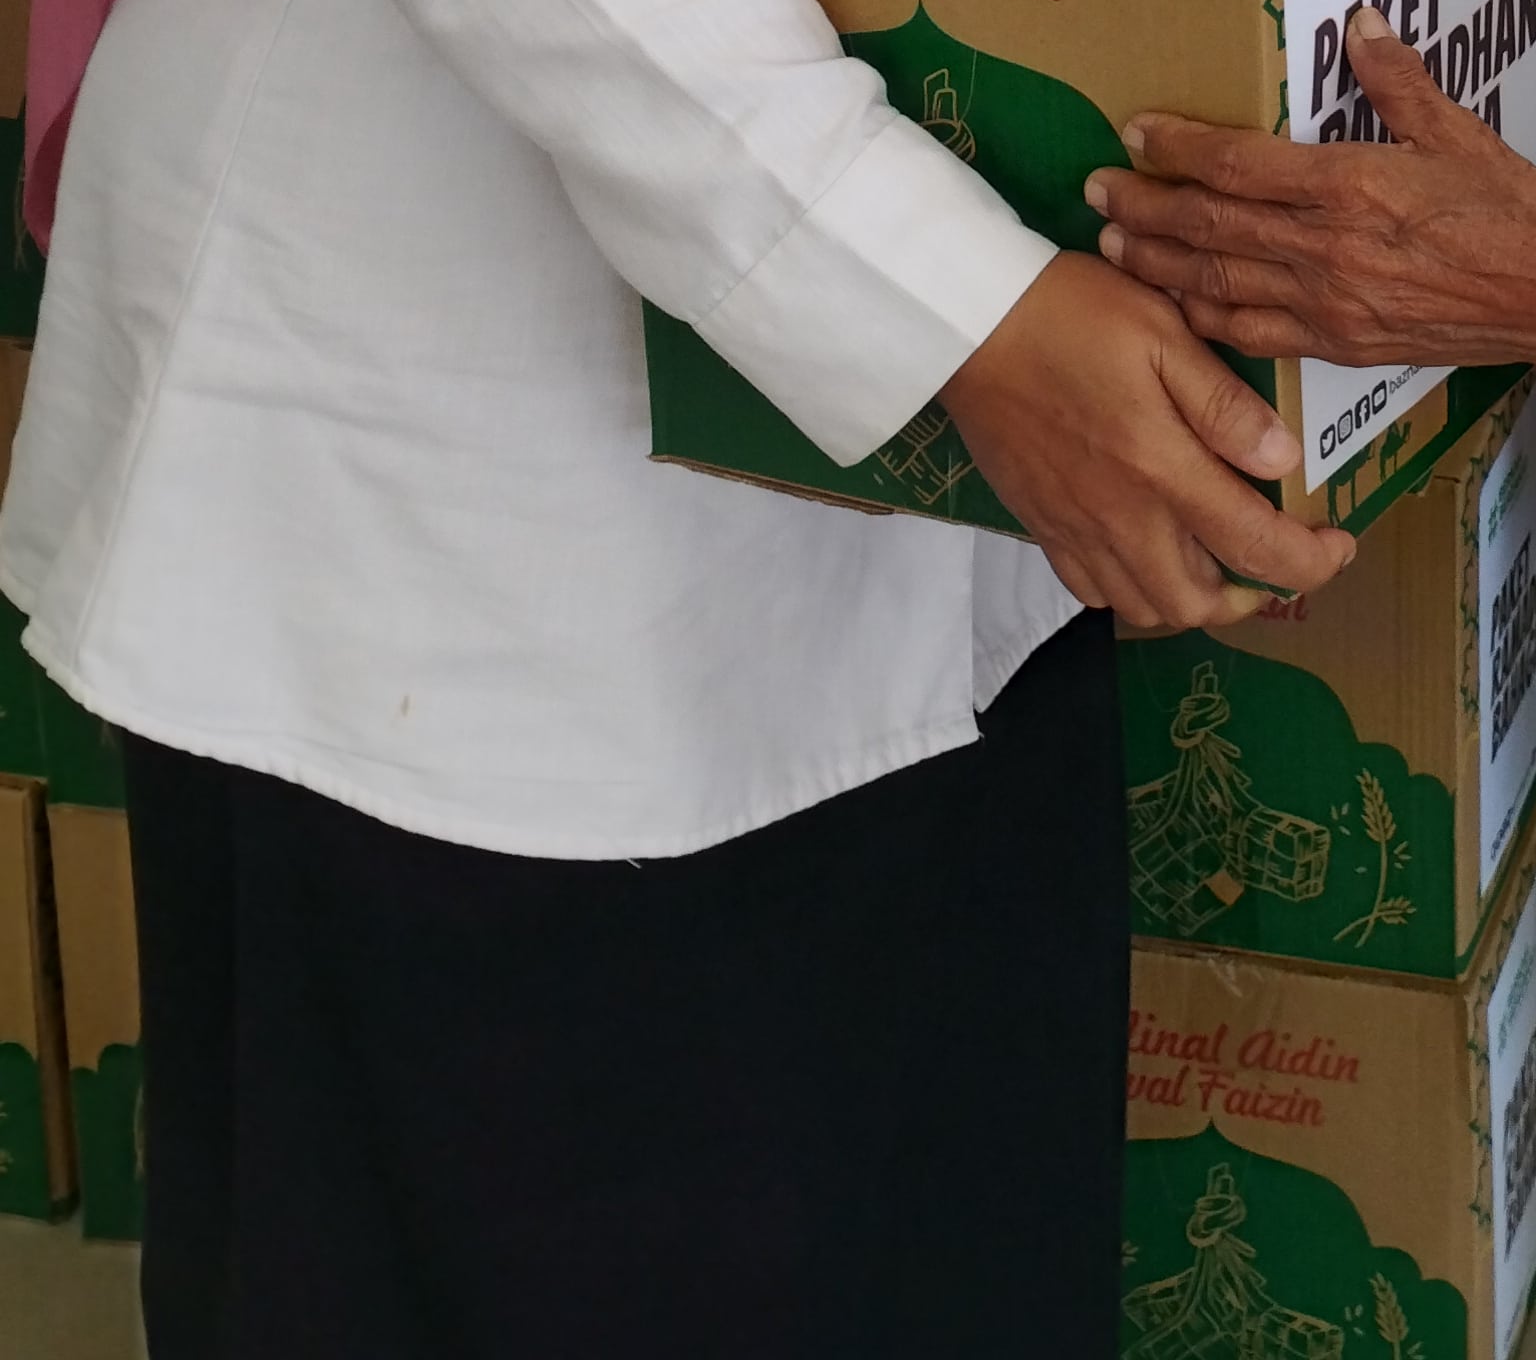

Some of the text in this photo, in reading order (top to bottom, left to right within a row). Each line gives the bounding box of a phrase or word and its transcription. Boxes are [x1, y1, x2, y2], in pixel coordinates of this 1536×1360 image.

[1128, 1009, 1360, 1084] inal Aidin
[1197, 1067, 1326, 1127] Faizin
